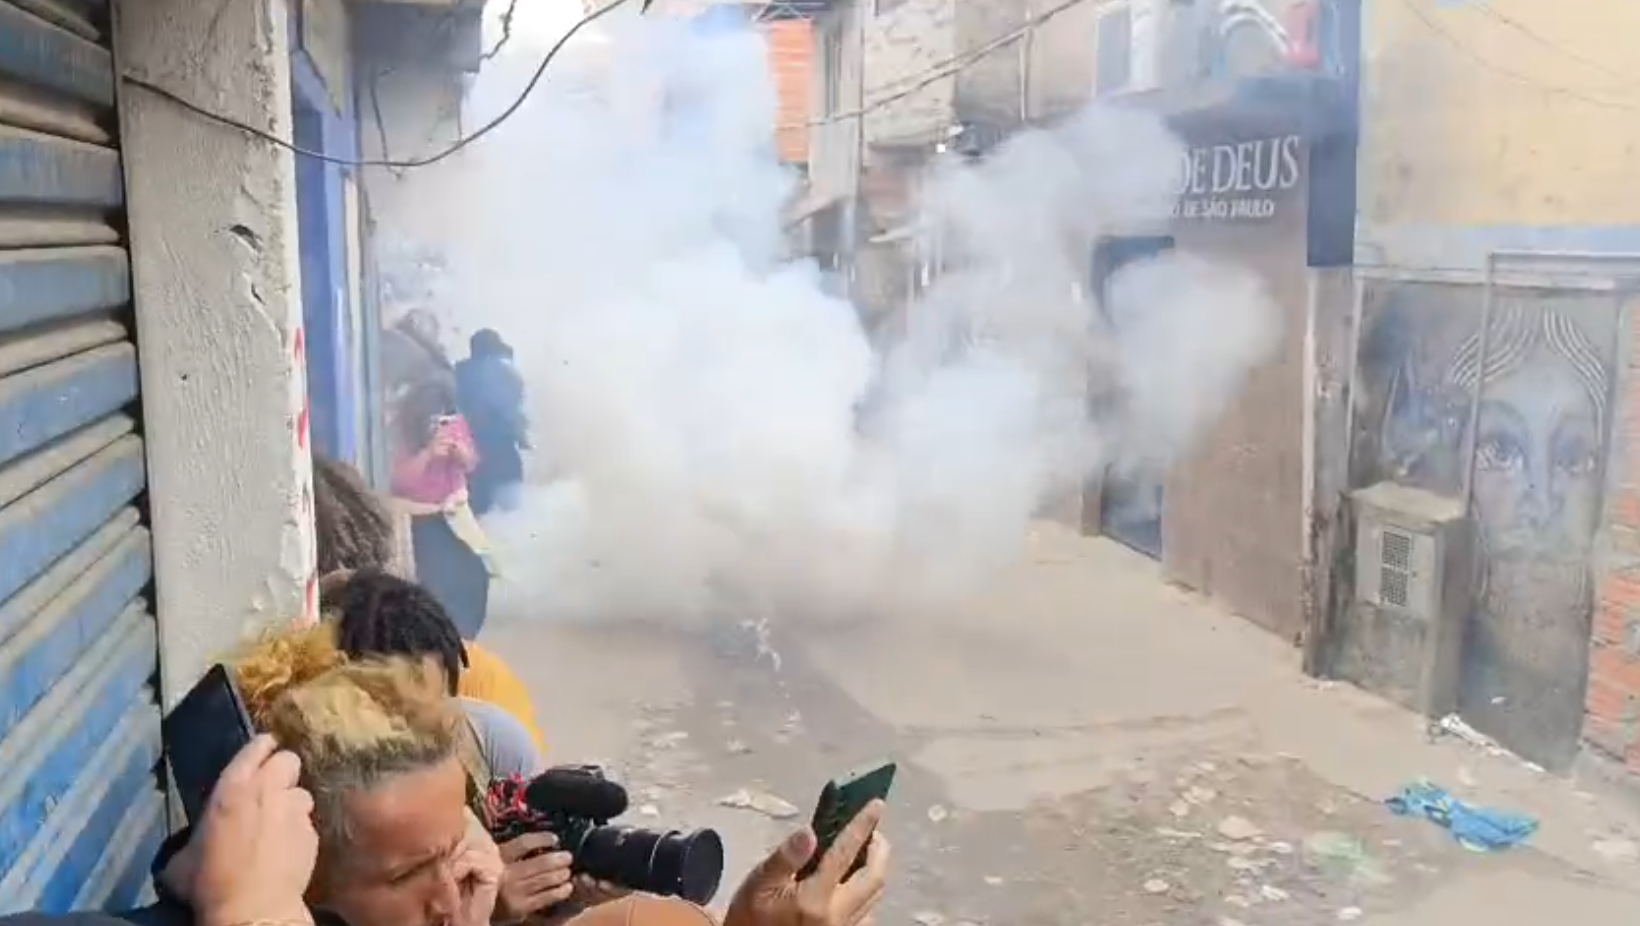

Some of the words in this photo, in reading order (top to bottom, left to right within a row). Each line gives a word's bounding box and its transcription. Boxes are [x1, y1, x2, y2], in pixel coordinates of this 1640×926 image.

[1173, 147, 1205, 194] DE
[1212, 135, 1299, 193] DEUS
[1230, 198, 1275, 217] PAULO
